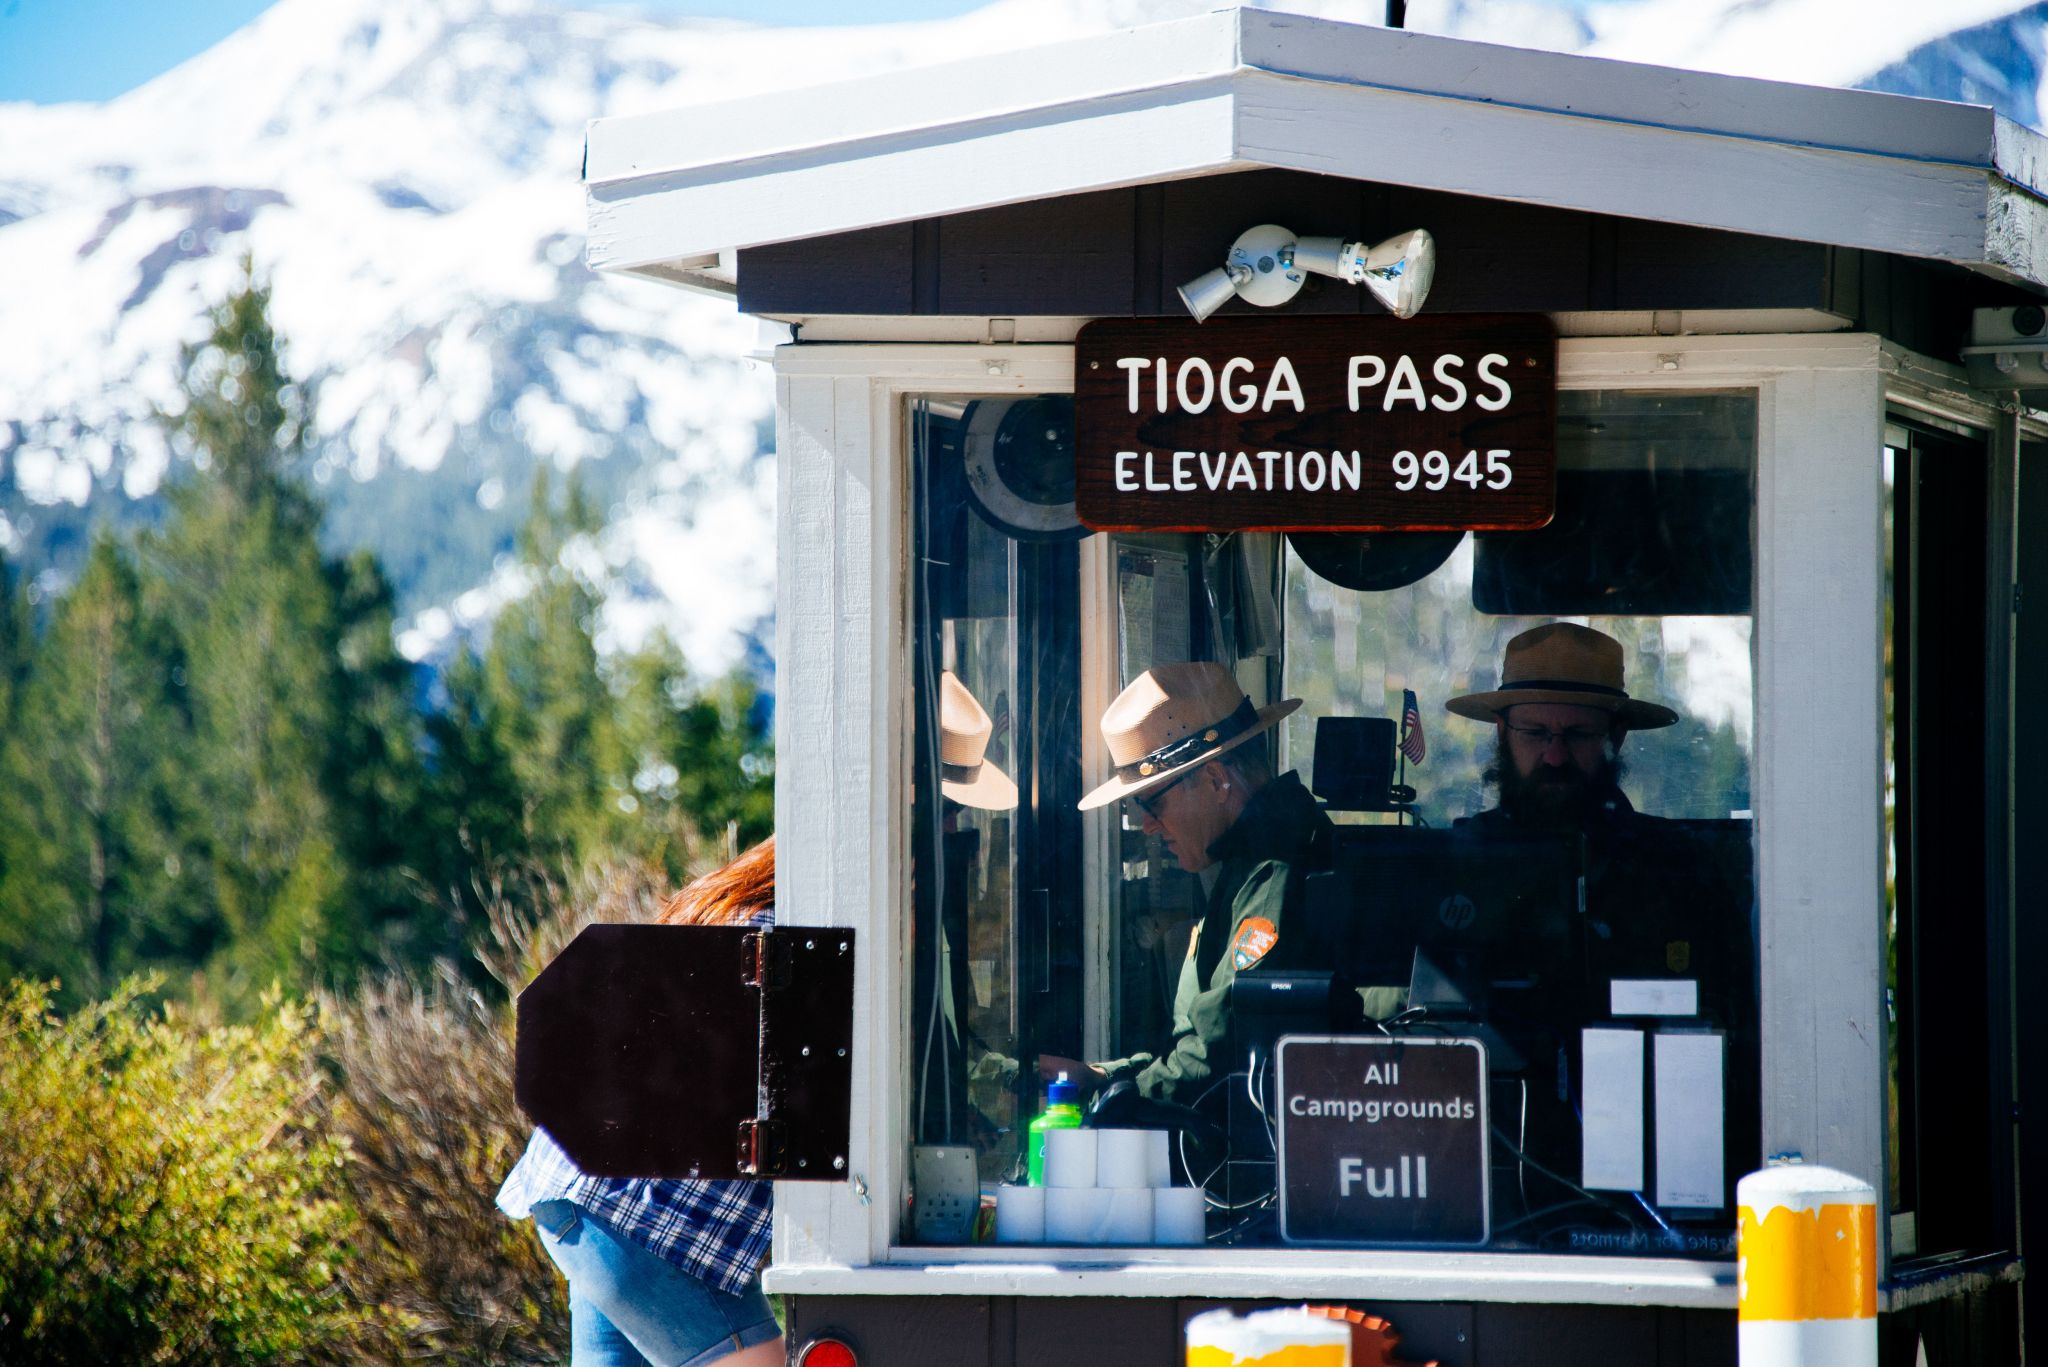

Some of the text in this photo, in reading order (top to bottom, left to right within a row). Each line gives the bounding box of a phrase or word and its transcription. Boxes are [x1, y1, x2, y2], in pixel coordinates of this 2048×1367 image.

[1116, 353, 1512, 414] TIOGA PASS
[1115, 449, 1512, 491] ELEVATION 9945
[1363, 1063, 1399, 1085] All
[1289, 1095, 1475, 1123] Campgrounds
[1339, 1155, 1427, 1199] Full
